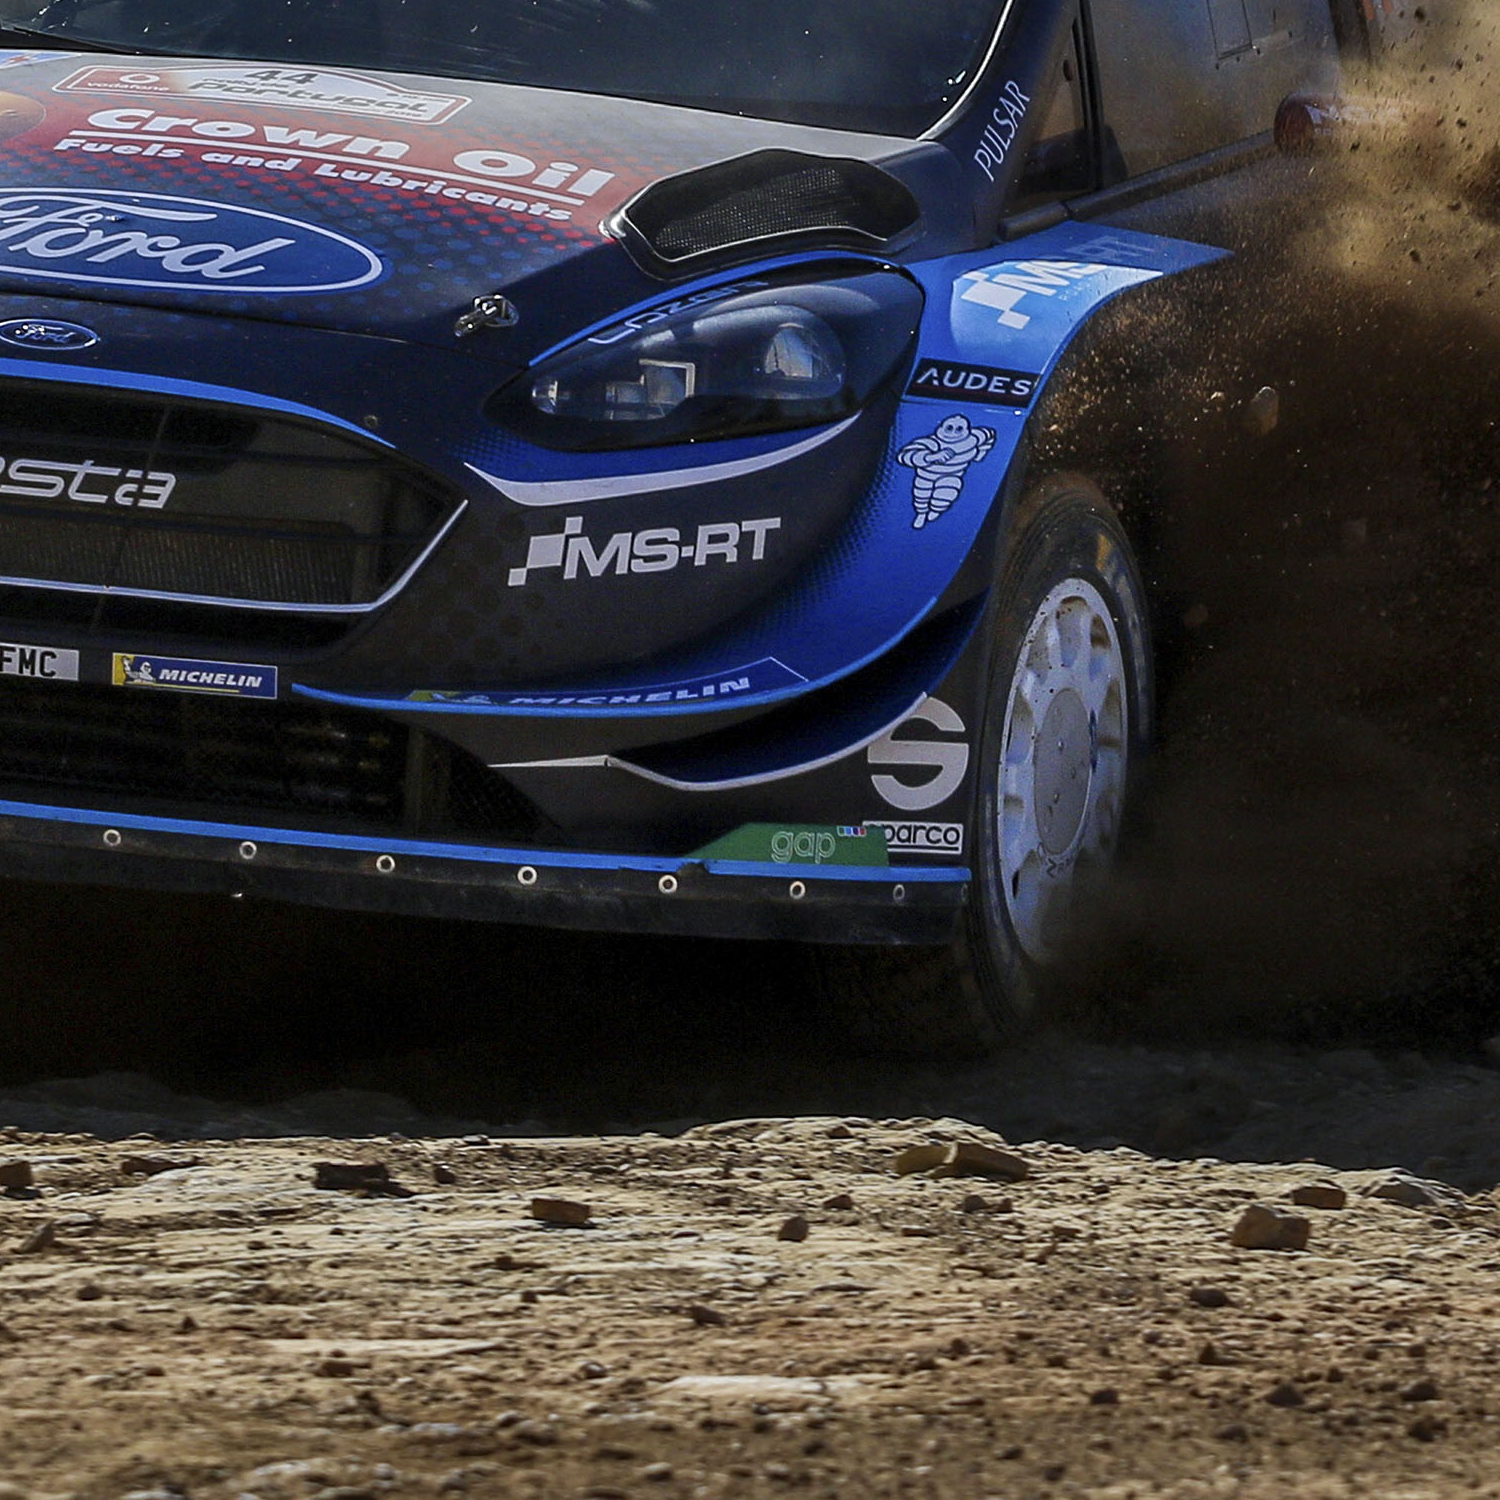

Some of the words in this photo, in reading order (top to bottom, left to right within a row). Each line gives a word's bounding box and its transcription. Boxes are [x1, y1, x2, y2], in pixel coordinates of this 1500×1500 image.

[86, 82, 170, 92] vodafone
[243, 69, 320, 85] 44
[188, 81, 428, 113] portugal
[974, 80, 1030, 182] PULSAR
[87, 108, 412, 160] Crown
[453, 150, 616, 198] Oil
[54, 138, 185, 159] Fuels
[200, 151, 302, 172] and
[314, 163, 573, 222] Lubricants
[13, 323, 77, 344] Ford
[916, 367, 1033, 396] AUDES
[563, 517, 781, 580] MS-RT
[158, 667, 263, 689] MICHELIN
[510, 676, 751, 705] MICHELIN
[771, 831, 836, 864] gap
[883, 823, 961, 846] parco
